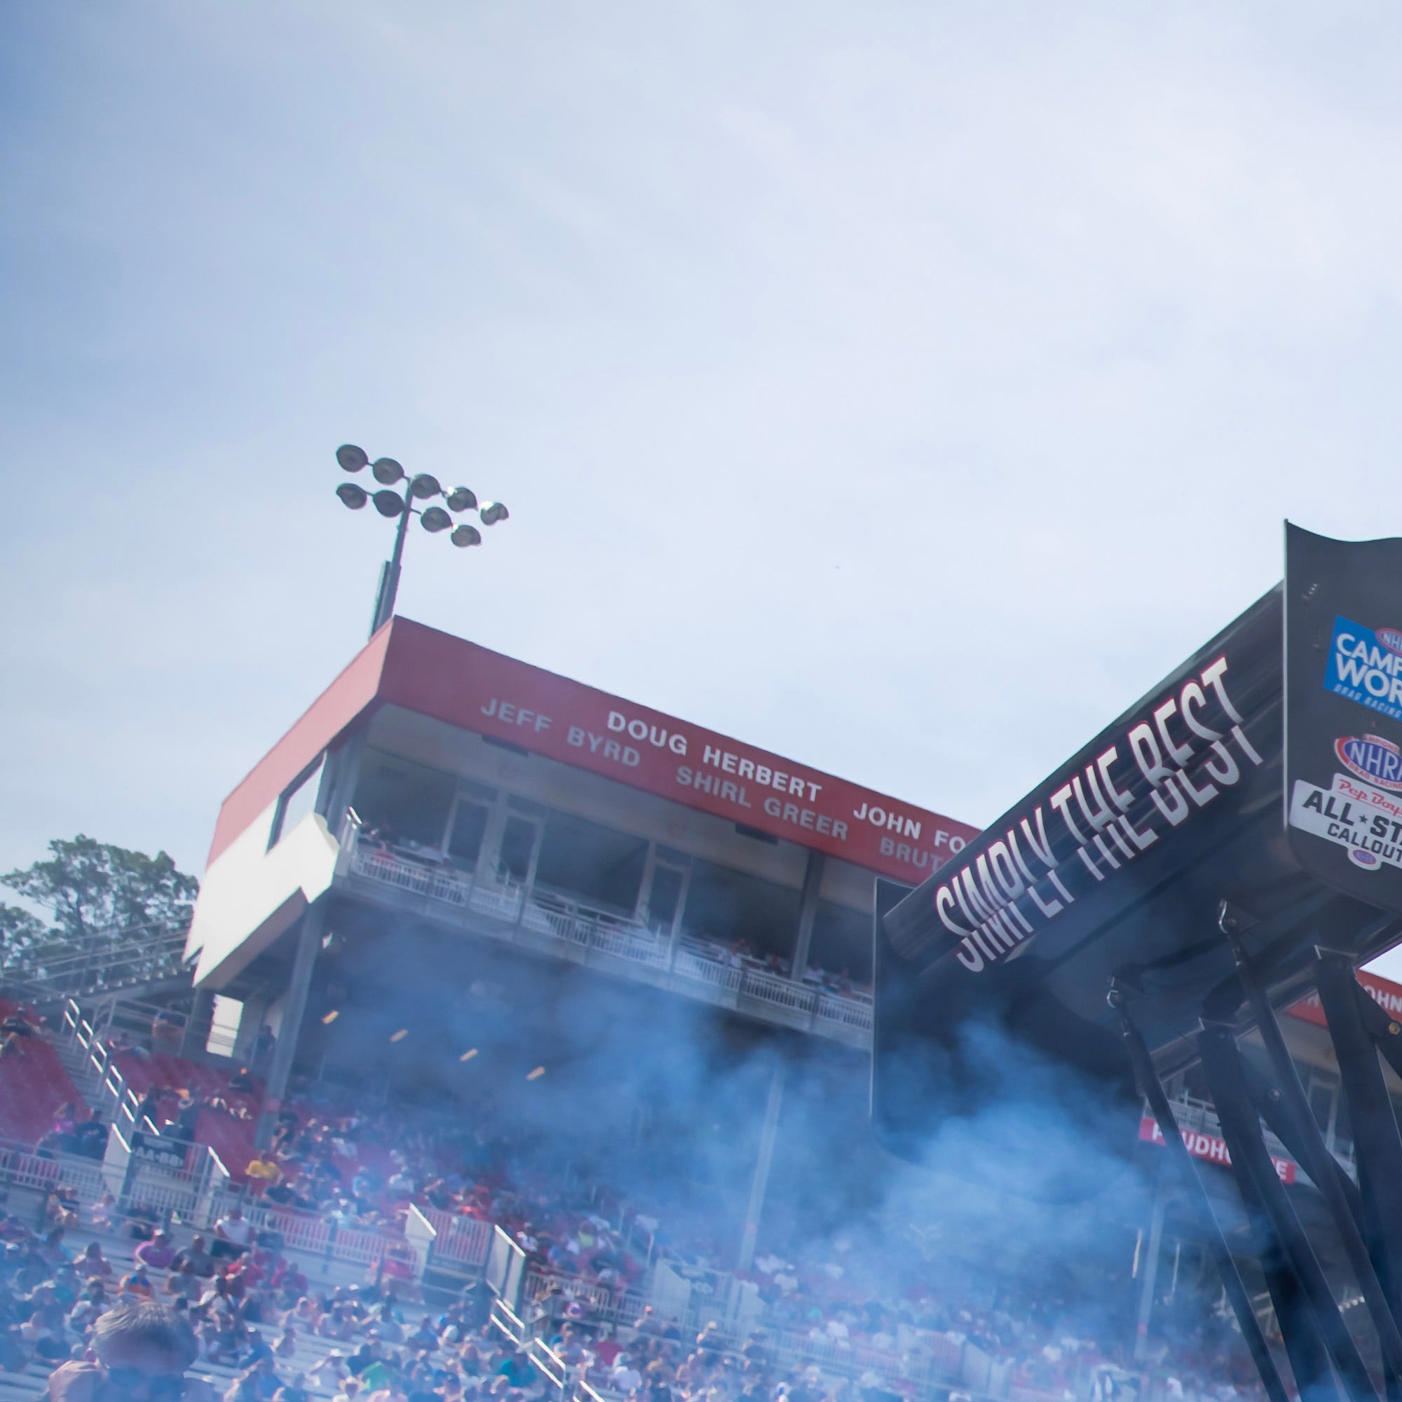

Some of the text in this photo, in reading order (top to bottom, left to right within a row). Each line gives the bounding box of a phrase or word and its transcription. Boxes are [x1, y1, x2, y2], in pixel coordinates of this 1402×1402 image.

[1333, 684, 1363, 701] DRAG
[1364, 696, 1402, 719] RACING
[480, 698, 641, 768] JEFF BYRD
[607, 711, 822, 802] DOUG HERBERT
[676, 765, 849, 841] SHIRL GREER
[935, 655, 1265, 973] SIMPLY THE BEST
[1302, 790, 1355, 826] ALL
[1339, 779, 1368, 801] Pep
[853, 803, 922, 840] JOHN
